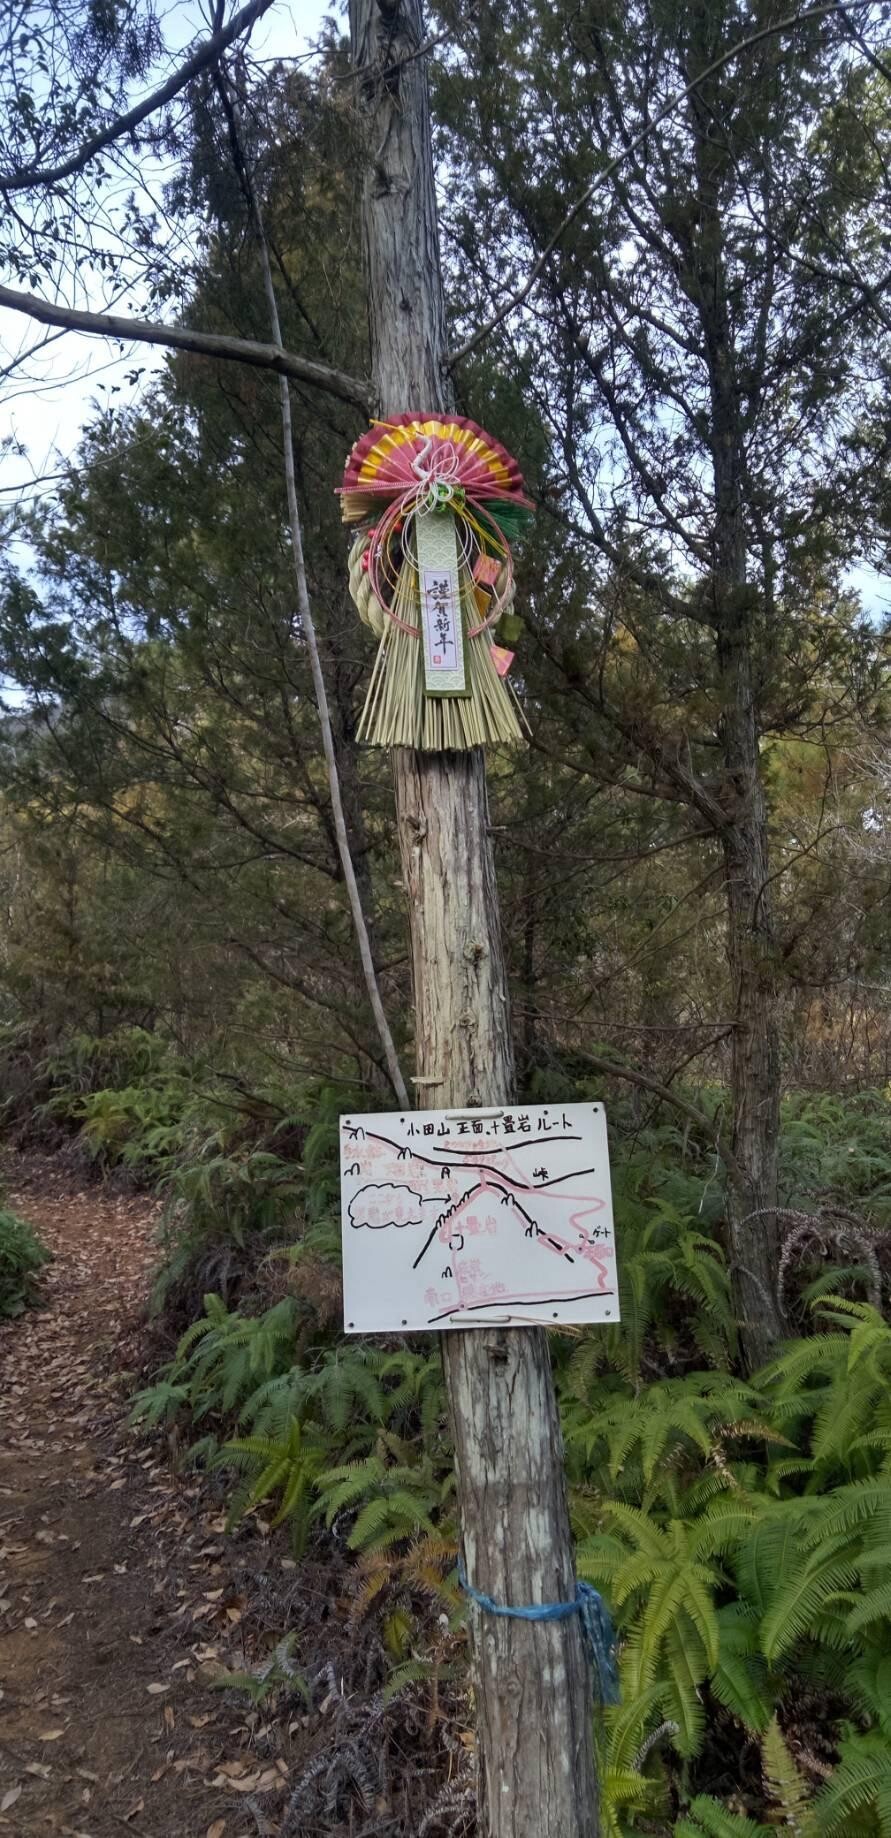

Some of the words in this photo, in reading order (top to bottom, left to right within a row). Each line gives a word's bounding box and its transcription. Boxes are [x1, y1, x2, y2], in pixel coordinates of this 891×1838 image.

[427, 579, 454, 655] 謹賀新年
[407, 1121, 451, 1136] 小田山
